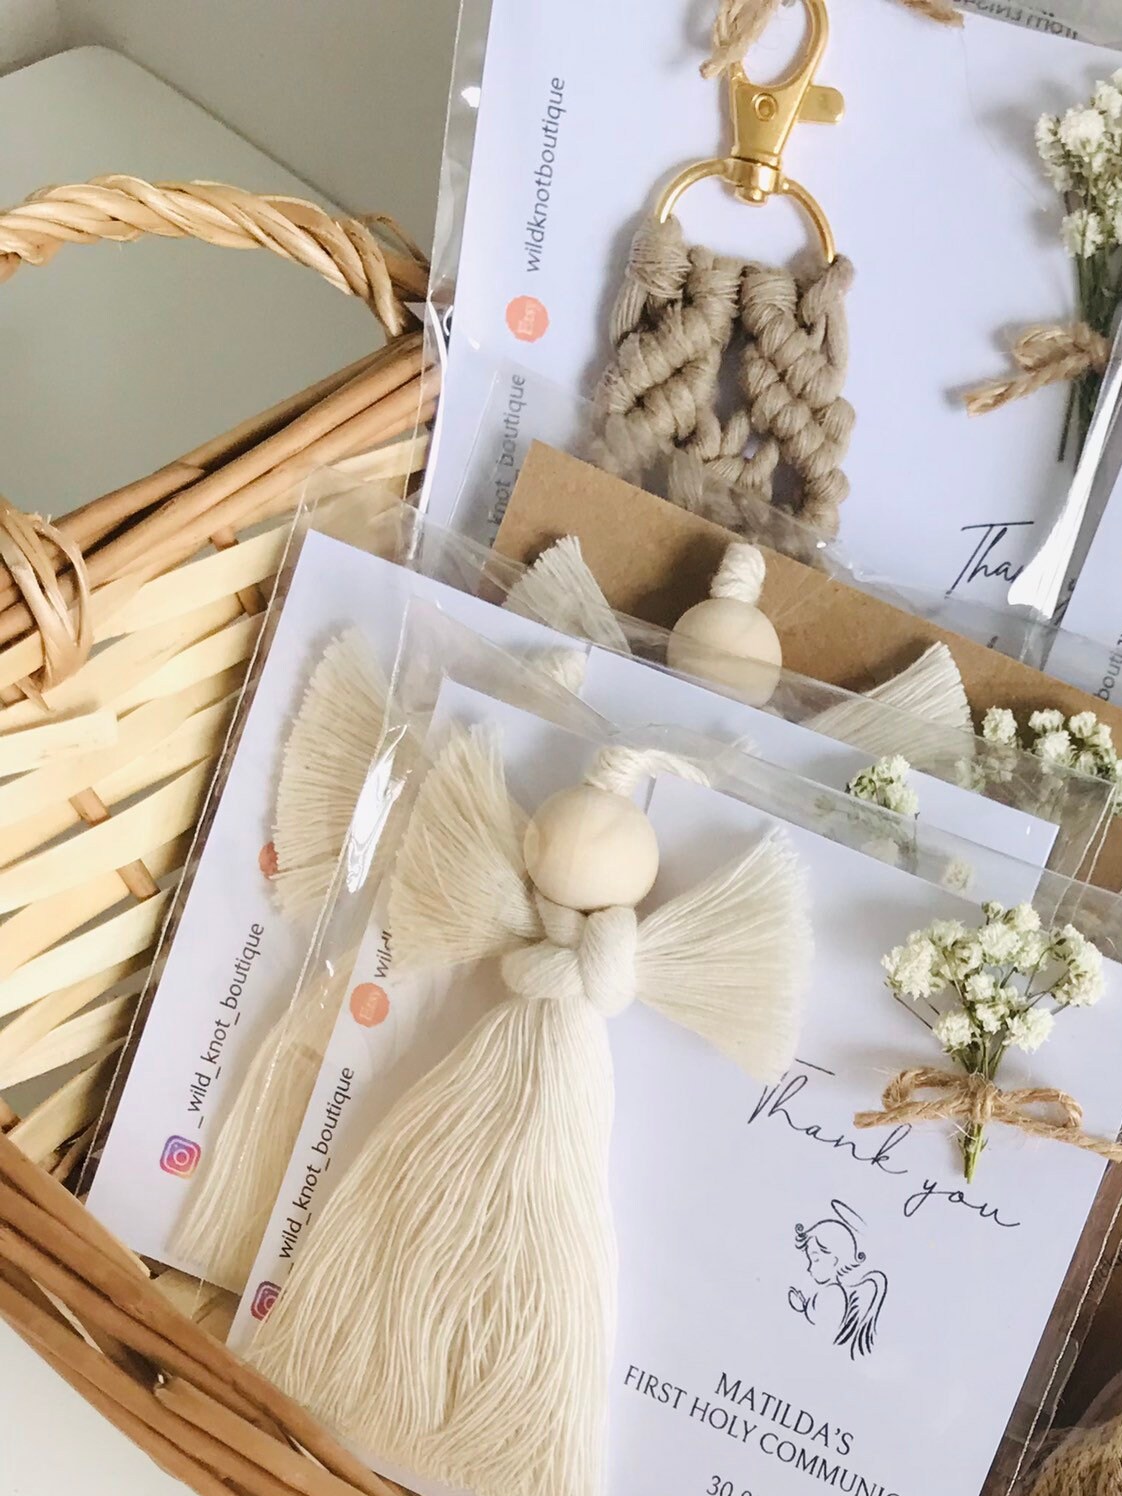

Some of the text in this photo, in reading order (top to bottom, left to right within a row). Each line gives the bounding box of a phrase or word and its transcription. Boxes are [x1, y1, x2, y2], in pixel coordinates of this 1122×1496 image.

[526, 76, 567, 272] wildknotboutique
[944, 520, 1034, 600] Tha
[747, 1057, 1021, 1228] Thank you
[623, 1364, 688, 1410] FIRST
[688, 1396, 758, 1444] HOLY
[714, 1371, 855, 1456] MATILDA'S
